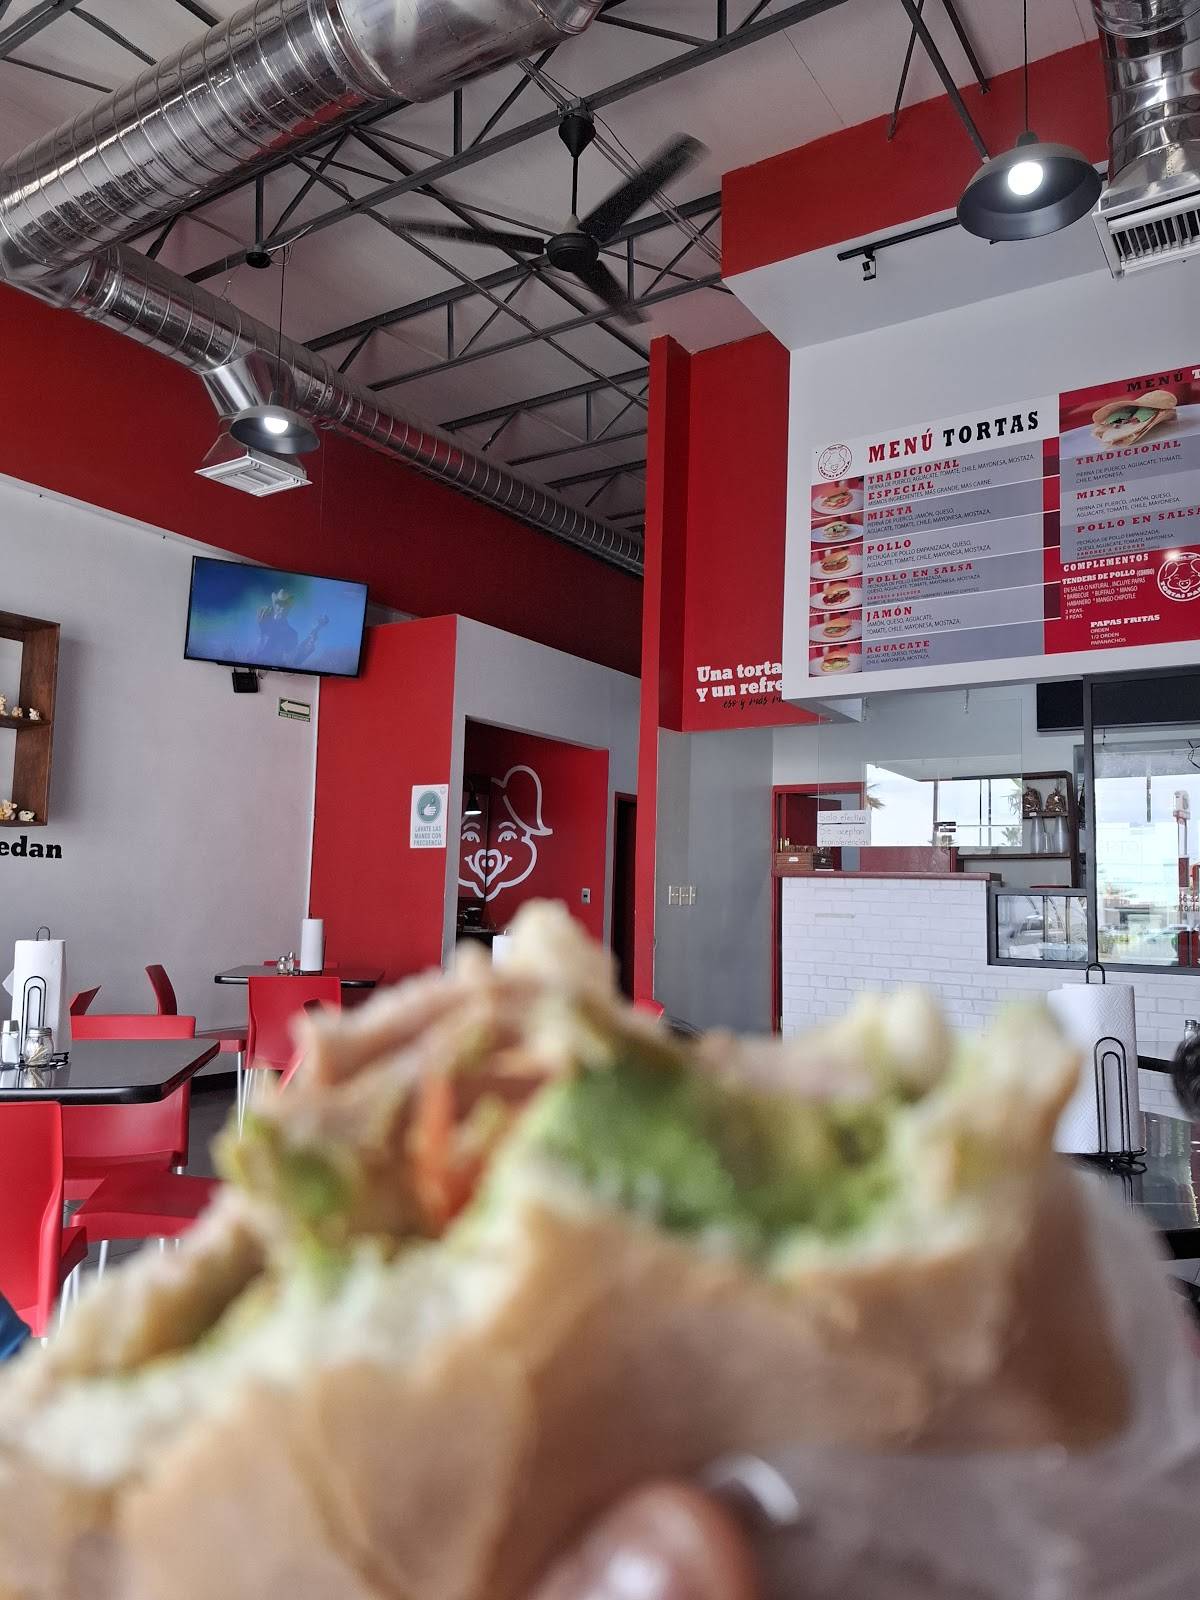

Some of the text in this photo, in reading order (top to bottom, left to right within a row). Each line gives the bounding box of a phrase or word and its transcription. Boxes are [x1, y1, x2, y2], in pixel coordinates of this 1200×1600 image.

[1127, 371, 1183, 392] MENÚ
[868, 411, 1039, 463] MENÚ TORTAS
[1075, 440, 1181, 465] TRADICIONAL
[868, 460, 960, 484] TRADICIONAL
[868, 481, 934, 500] ESPECIAL
[1076, 485, 1126, 500] MIXTA
[868, 506, 913, 521] MIXTA
[1076, 519, 1126, 534] POLLO
[1132, 515, 1151, 525] EN
[867, 539, 912, 554] POLLO
[1063, 553, 1149, 572] COMPLEMENTOS
[867, 563, 973, 585] POLLO EN SALSA
[1062, 573, 1097, 585] TENDERS
[1097, 572, 1108, 580] DE
[1109, 569, 1135, 579] POLLO
[1070, 584, 1085, 593] SALSA
[1131, 577, 1146, 585] PAPAS
[1095, 588, 1116, 597] BUFFALO
[1120, 585, 1138, 594] MANGO
[1113, 592, 1137, 602] CHIPOTLE
[867, 605, 913, 622] JAMÓN
[1090, 614, 1160, 628] PAPAS FRITAS
[1100, 631, 1120, 640] ORDEN
[867, 640, 930, 653] AGUACATE
[696, 660, 783, 683] Una torta
[696, 676, 784, 702] y un refre
[0, 835, 63, 859] edan
